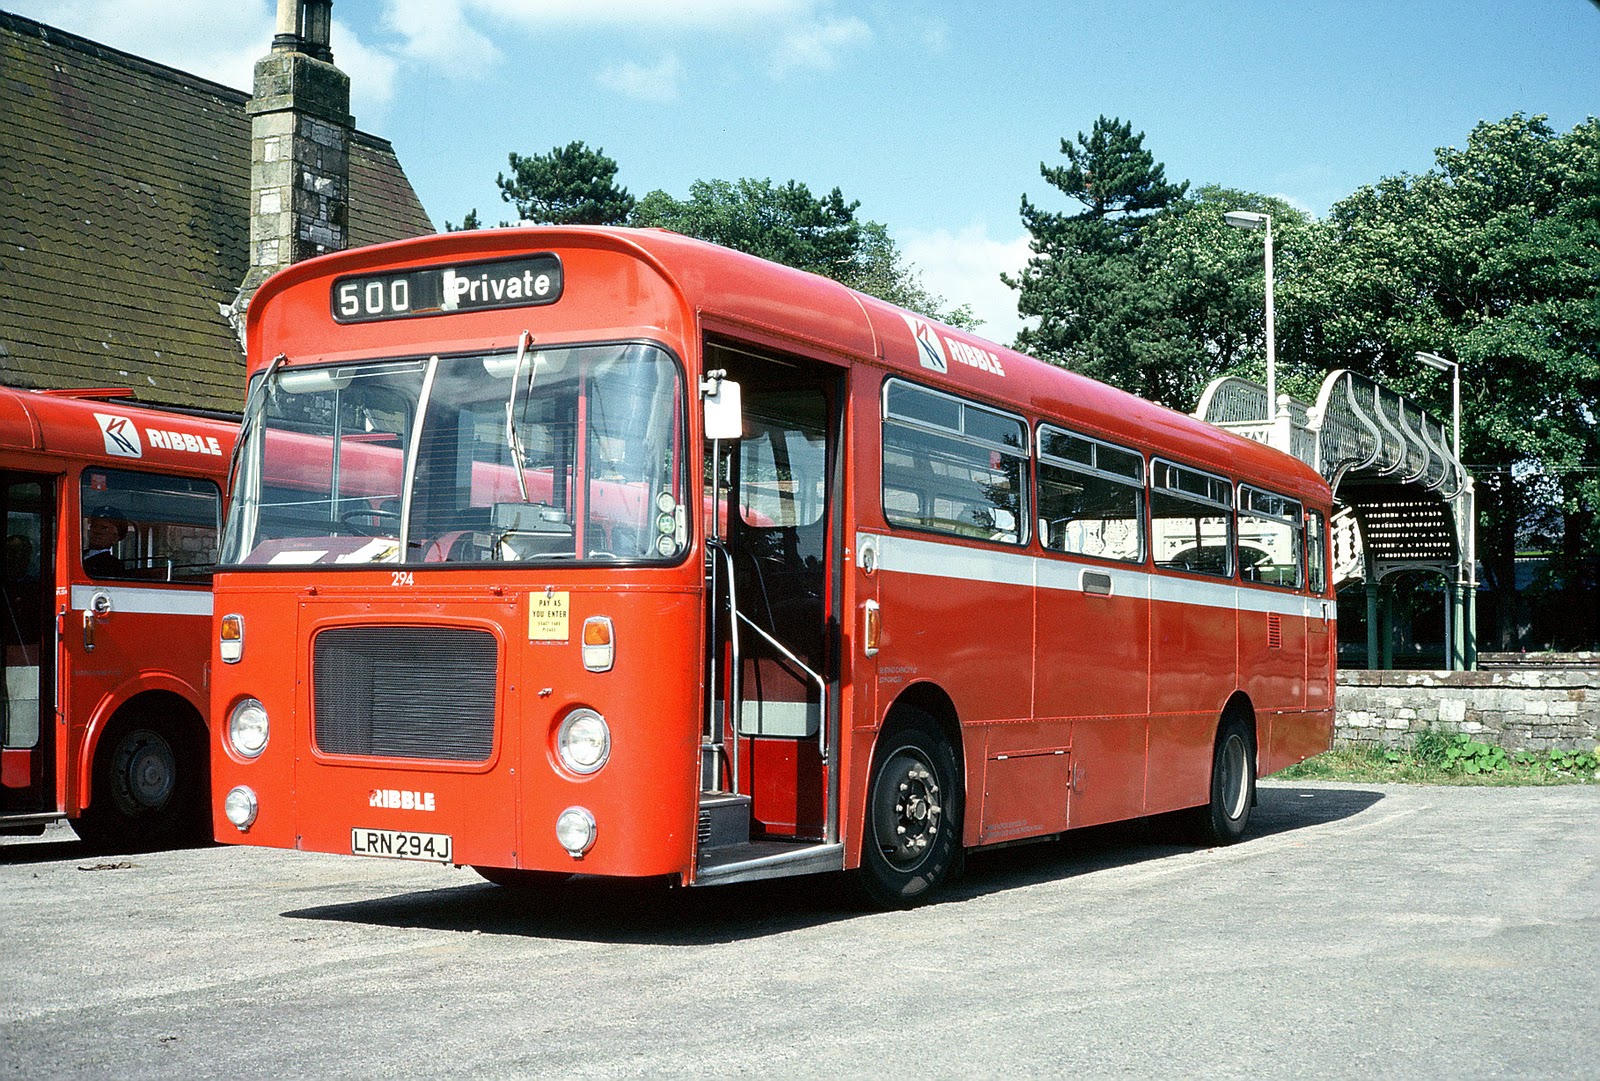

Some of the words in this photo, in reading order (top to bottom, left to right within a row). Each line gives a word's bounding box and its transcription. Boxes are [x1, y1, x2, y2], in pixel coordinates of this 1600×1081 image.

[340, 280, 409, 315] 500
[455, 270, 550, 303] Private
[943, 336, 1006, 377] RIBBLE
[145, 428, 223, 456] RIBBLE
[391, 571, 415, 586] 294
[532, 610, 545, 618] YOU
[548, 610, 567, 618] ENTER
[538, 599, 550, 607] PAY
[554, 599, 562, 607] AS
[368, 789, 436, 812] RIBBLE
[354, 831, 449, 858] LRN294J
